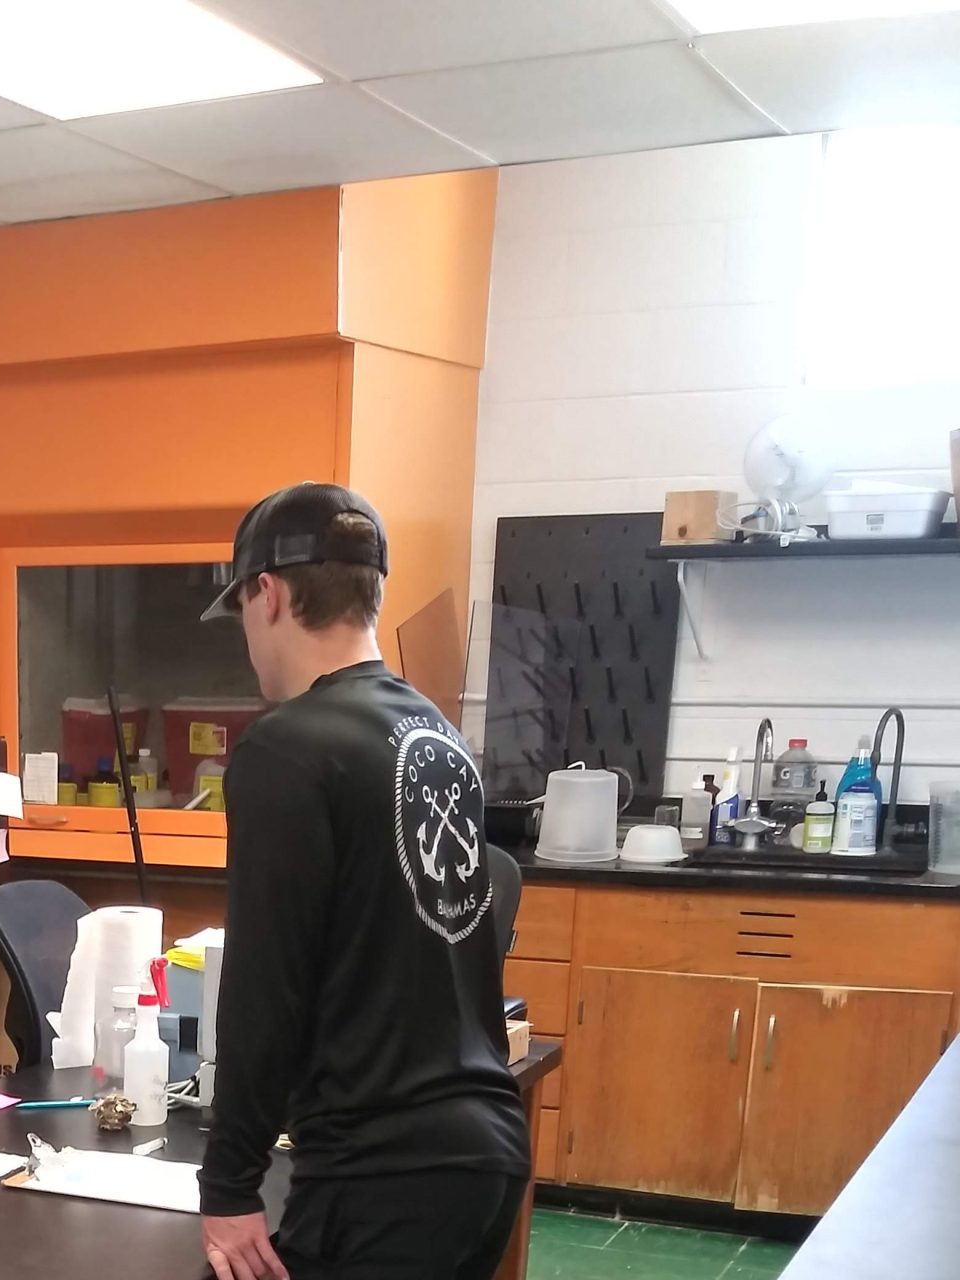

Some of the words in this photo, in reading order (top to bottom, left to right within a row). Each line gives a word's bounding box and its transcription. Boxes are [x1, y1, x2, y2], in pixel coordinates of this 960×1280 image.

[388, 716, 429, 747] PERFECT
[437, 722, 459, 745] DAY
[405, 745, 435, 803] COCO
[446, 752, 478, 792] CAY
